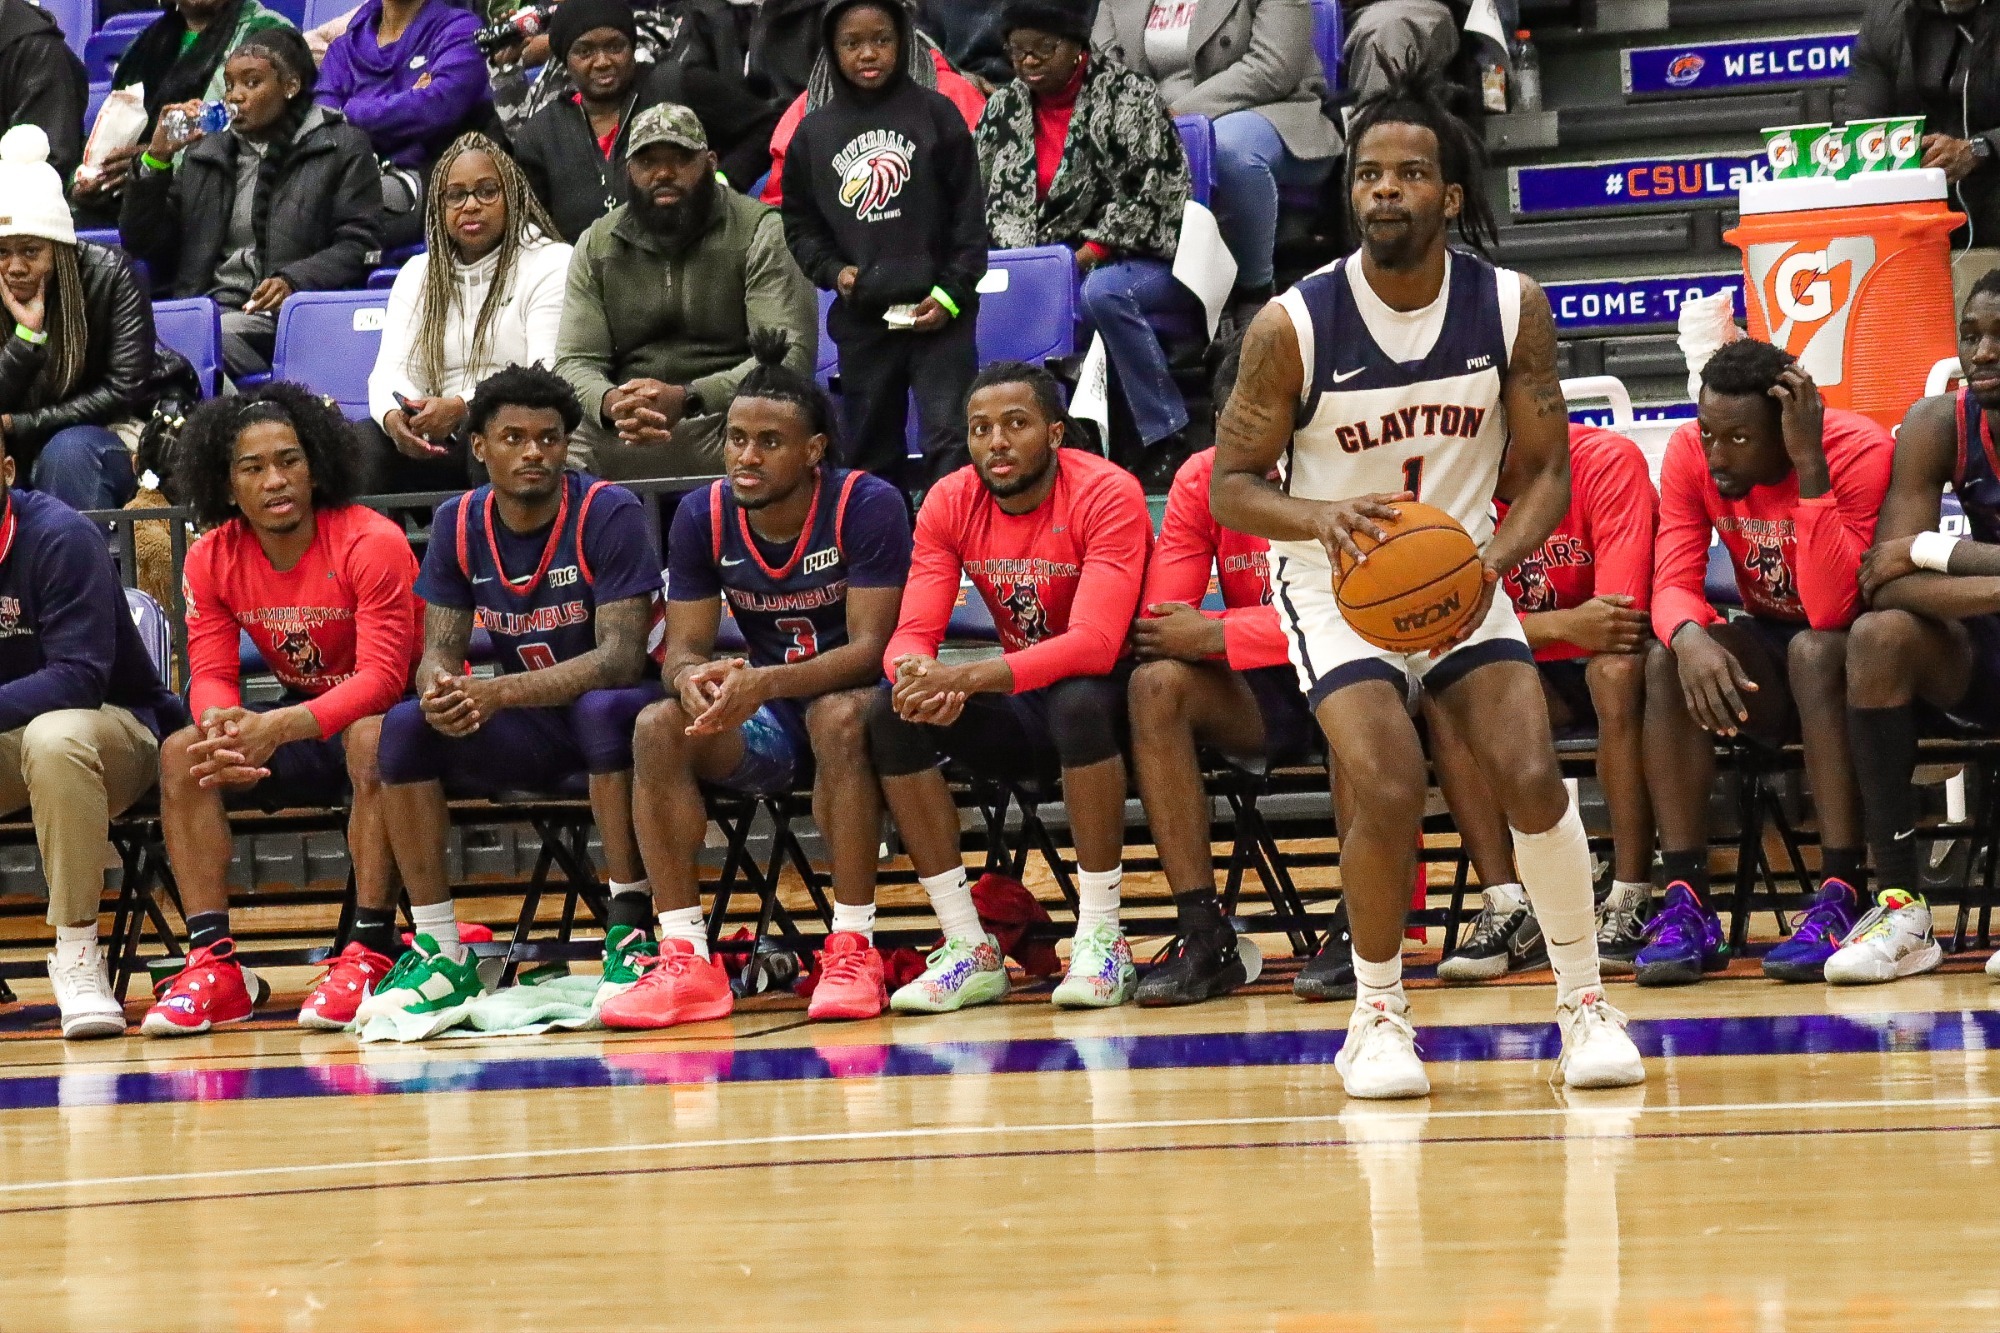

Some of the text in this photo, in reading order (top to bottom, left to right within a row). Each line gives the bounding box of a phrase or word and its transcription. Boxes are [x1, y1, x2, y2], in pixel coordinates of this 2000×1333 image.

[1724, 45, 1850, 77] WELCOM
[832, 129, 917, 177] RIVERDALE
[1605, 159, 1770, 196] #CSULak
[1552, 291, 1646, 319] COME
[1775, 250, 1833, 322] G
[1335, 404, 1486, 454] CLAYTON
[1402, 455, 1424, 502] 1
[803, 546, 839, 575] PBC
[775, 617, 818, 664] 3
